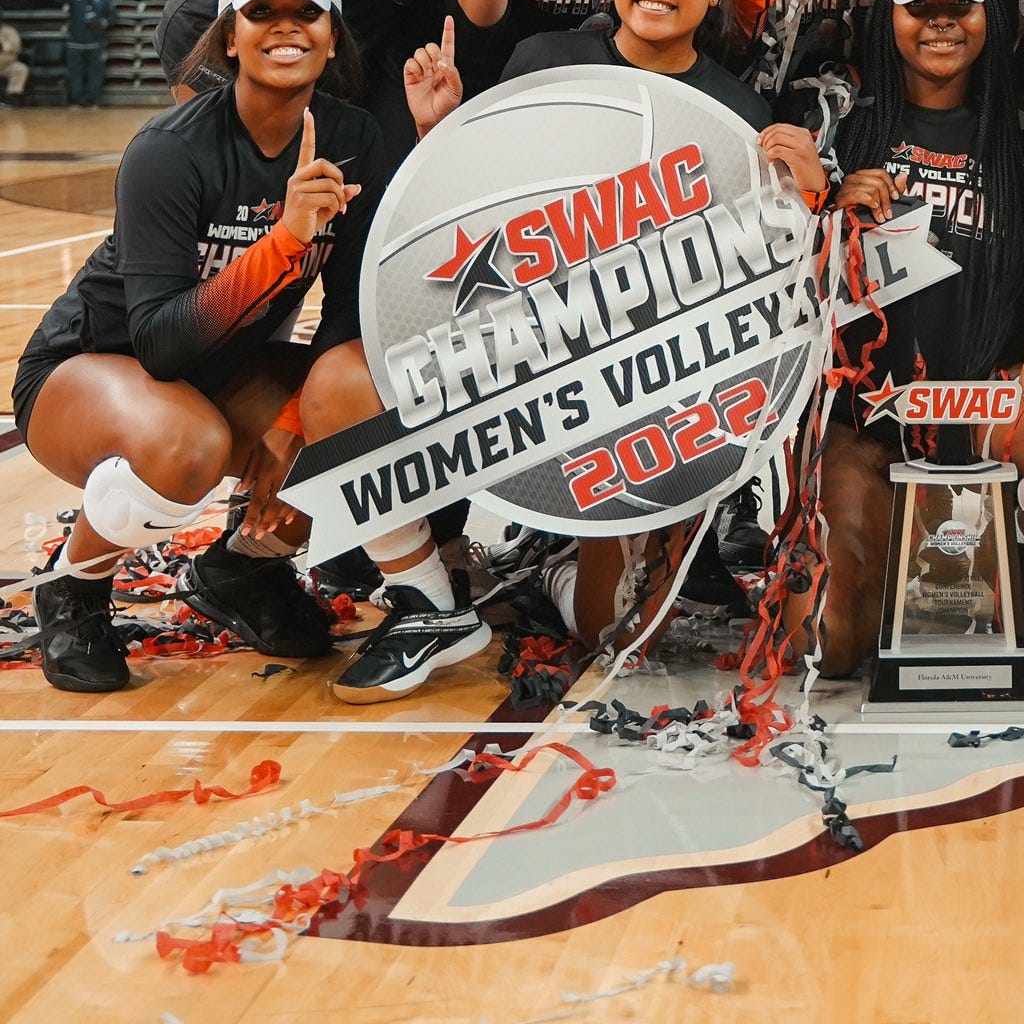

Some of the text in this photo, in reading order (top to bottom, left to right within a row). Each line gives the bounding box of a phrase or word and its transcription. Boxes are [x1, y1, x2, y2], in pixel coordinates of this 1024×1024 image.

[909, 146, 968, 169] SWAC
[236, 204, 249, 222] 20
[503, 141, 712, 287] SWAC
[207, 222, 264, 242] WOMEN'
[383, 183, 808, 429] CHAMPIONS
[340, 241, 908, 525] WOMEN'S VOLLEYL
[905, 386, 1017, 420] SWAC
[561, 376, 780, 512] 2022
[917, 673, 940, 681] Florida
[960, 672, 993, 682] University
